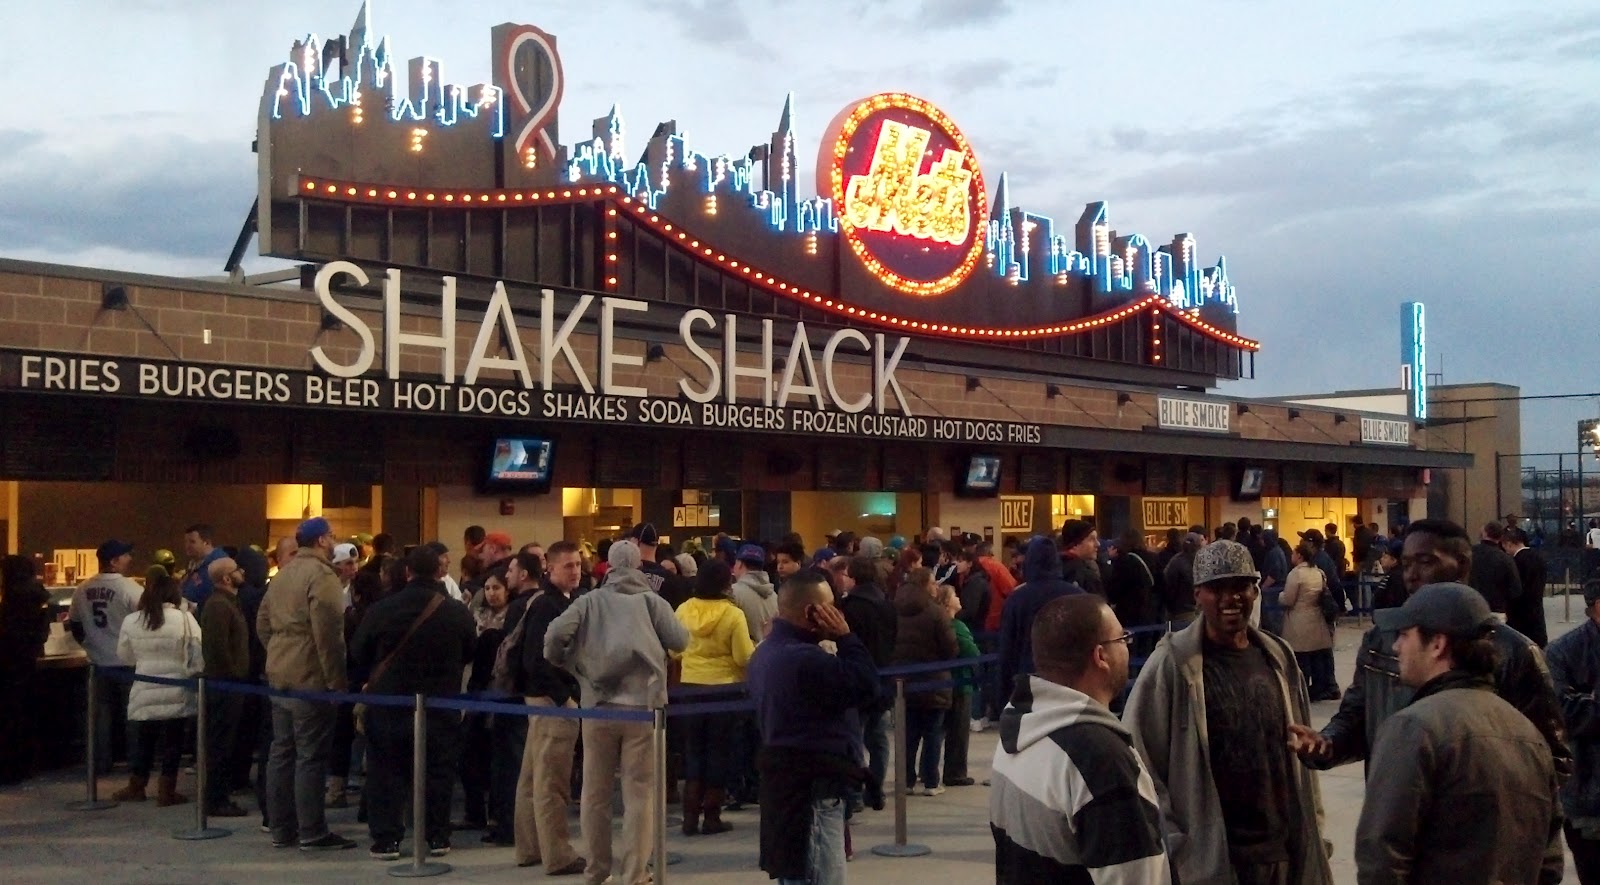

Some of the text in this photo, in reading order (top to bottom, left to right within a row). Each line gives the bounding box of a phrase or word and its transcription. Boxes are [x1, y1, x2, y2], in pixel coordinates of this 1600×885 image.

[310, 259, 910, 416] SHAKE SHACK
[20, 355, 1041, 444] FRIES BURGERS BEER HOT DOGS SHAKES SODA BURGERS FROZEN CUSTARD HOT DOGS FRIES
[1161, 400, 1229, 430] BLUE SMOKE
[1363, 419, 1408, 443] BLUE SMOKE
[675, 510, 684, 522] A
[1146, 501, 1173, 526] BLUE
[93, 602, 108, 628] 5
